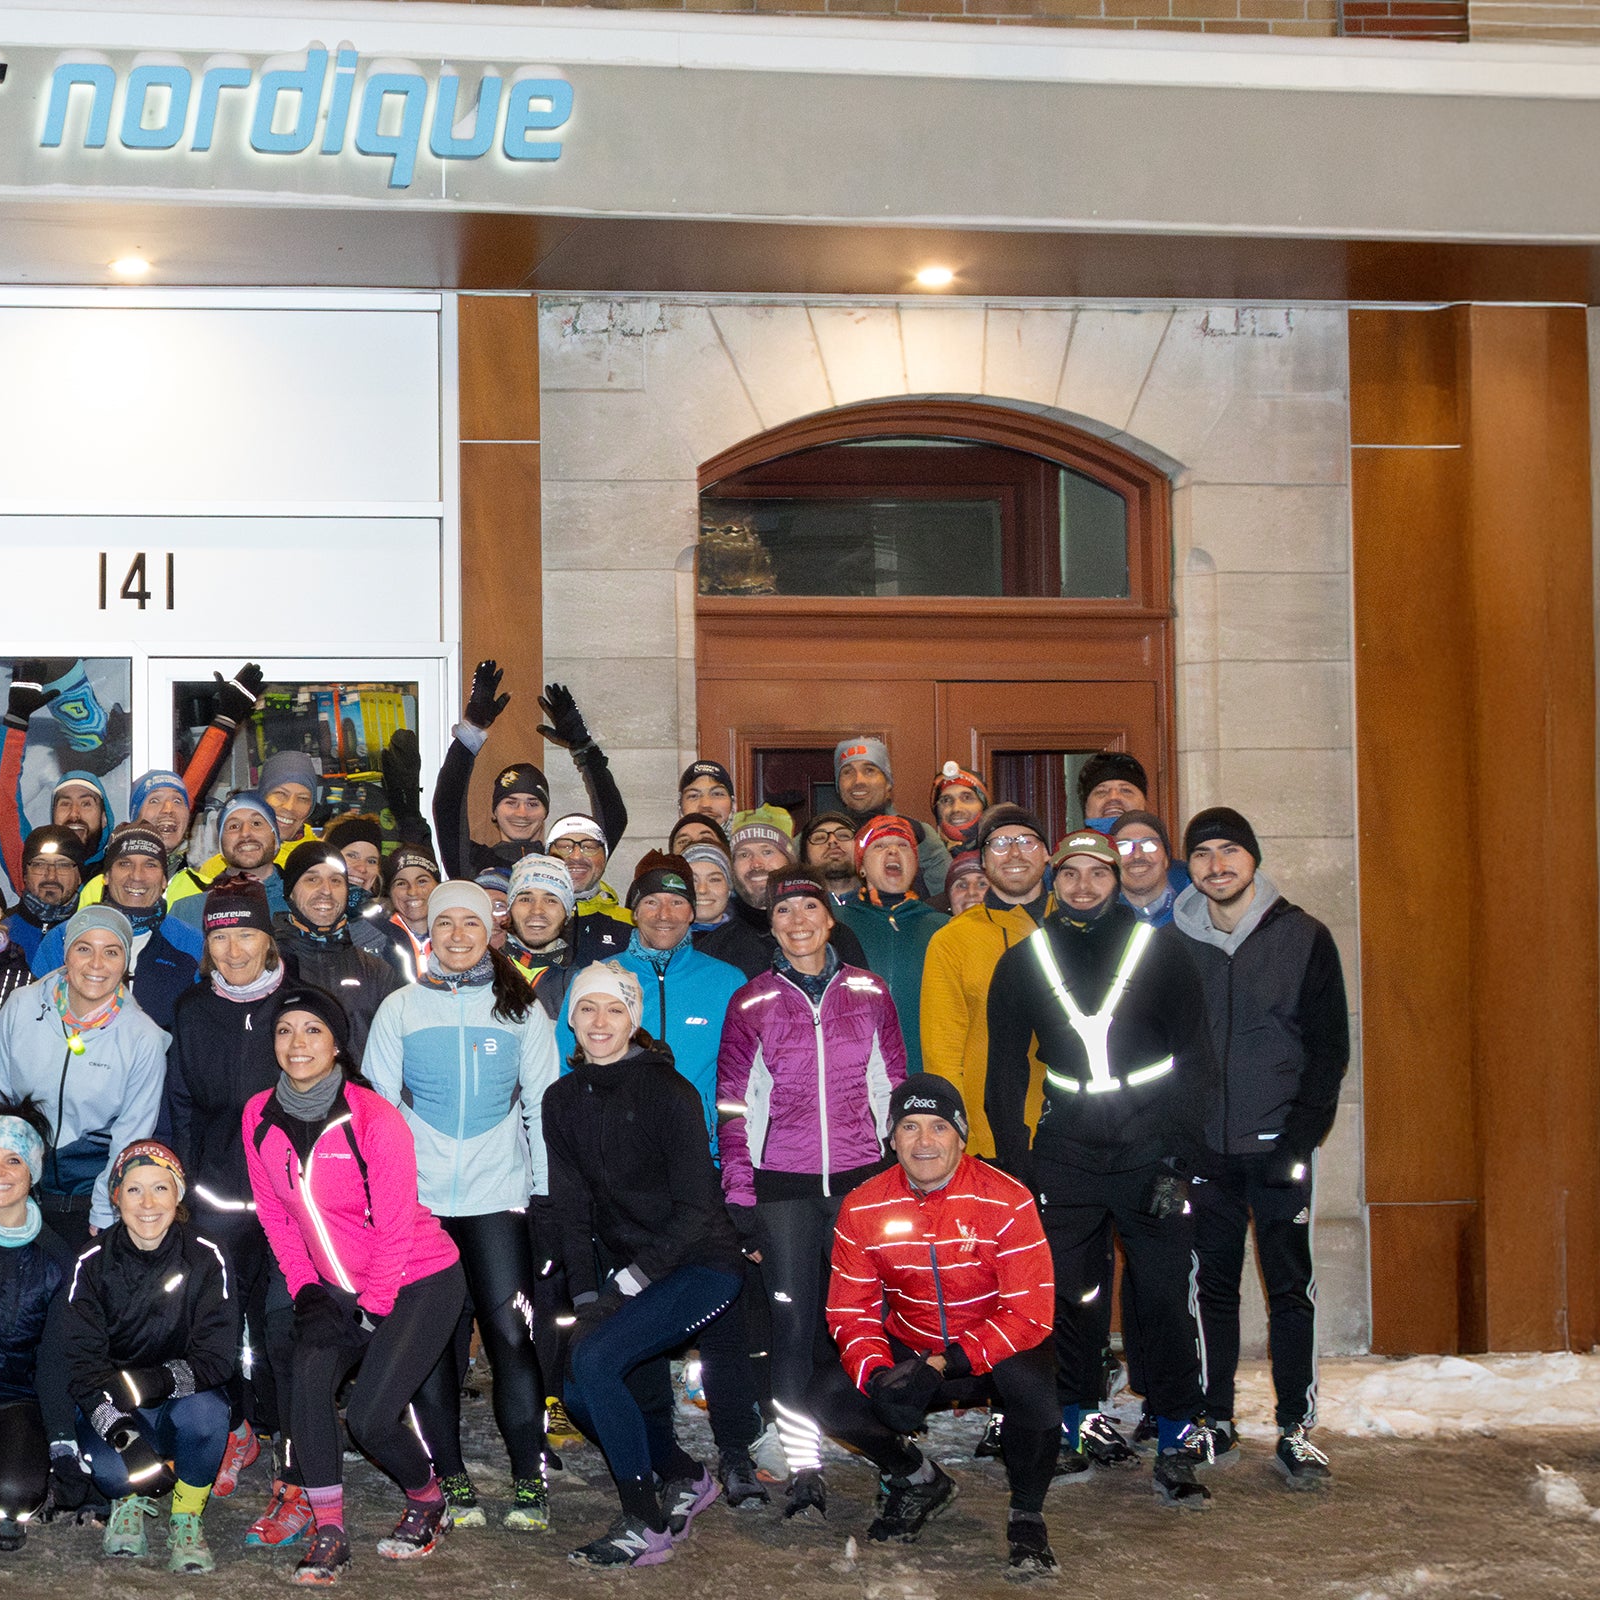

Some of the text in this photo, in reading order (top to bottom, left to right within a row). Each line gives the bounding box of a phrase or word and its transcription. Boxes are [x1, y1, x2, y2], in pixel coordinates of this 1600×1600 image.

[39, 48, 574, 189] nordique
[98, 551, 175, 610] 141
[212, 910, 252, 920] coureuse
[912, 1097, 938, 1109] asics
